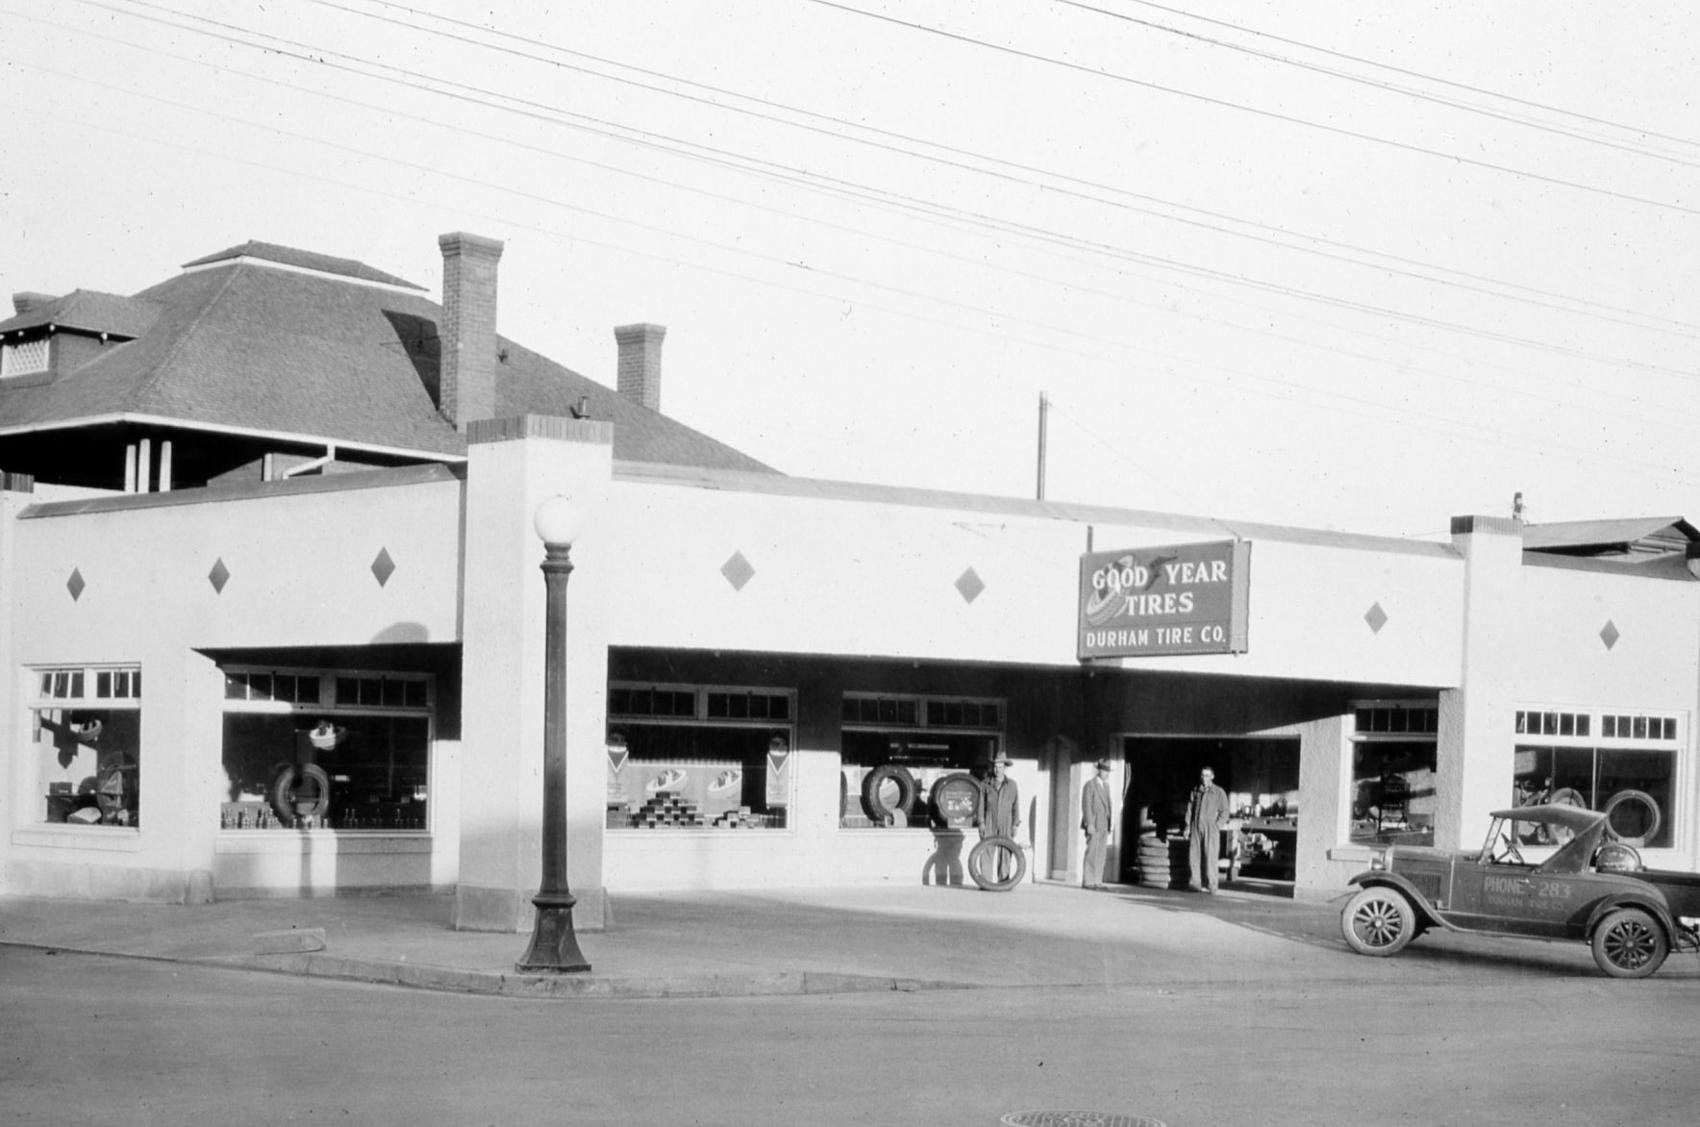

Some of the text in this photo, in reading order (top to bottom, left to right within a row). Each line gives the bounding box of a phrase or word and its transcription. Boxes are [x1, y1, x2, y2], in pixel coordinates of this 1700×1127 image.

[1092, 560, 1228, 589] GOOD YEAR
[1125, 592, 1194, 616] TIRES
[1086, 625, 1227, 648] DURHAM TIRE CO.
[1484, 876, 1525, 895] PHONE
[1538, 880, 1571, 898] 283
